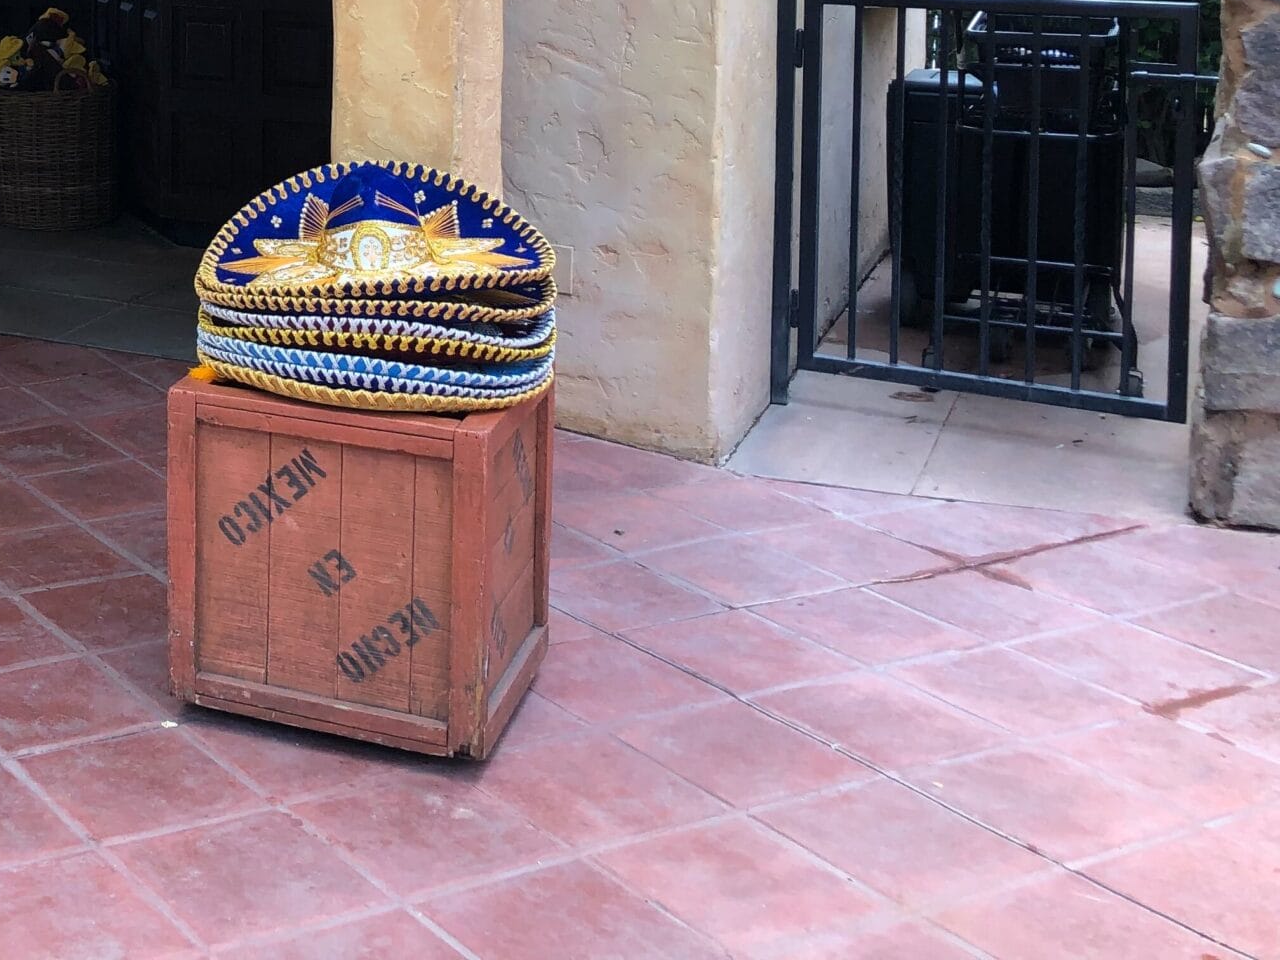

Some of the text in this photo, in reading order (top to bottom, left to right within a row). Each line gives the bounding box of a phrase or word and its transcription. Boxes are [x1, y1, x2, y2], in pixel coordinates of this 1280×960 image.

[218, 448, 327, 546] MEXICO
[307, 549, 357, 598] EN
[337, 596, 441, 683] HECHO
